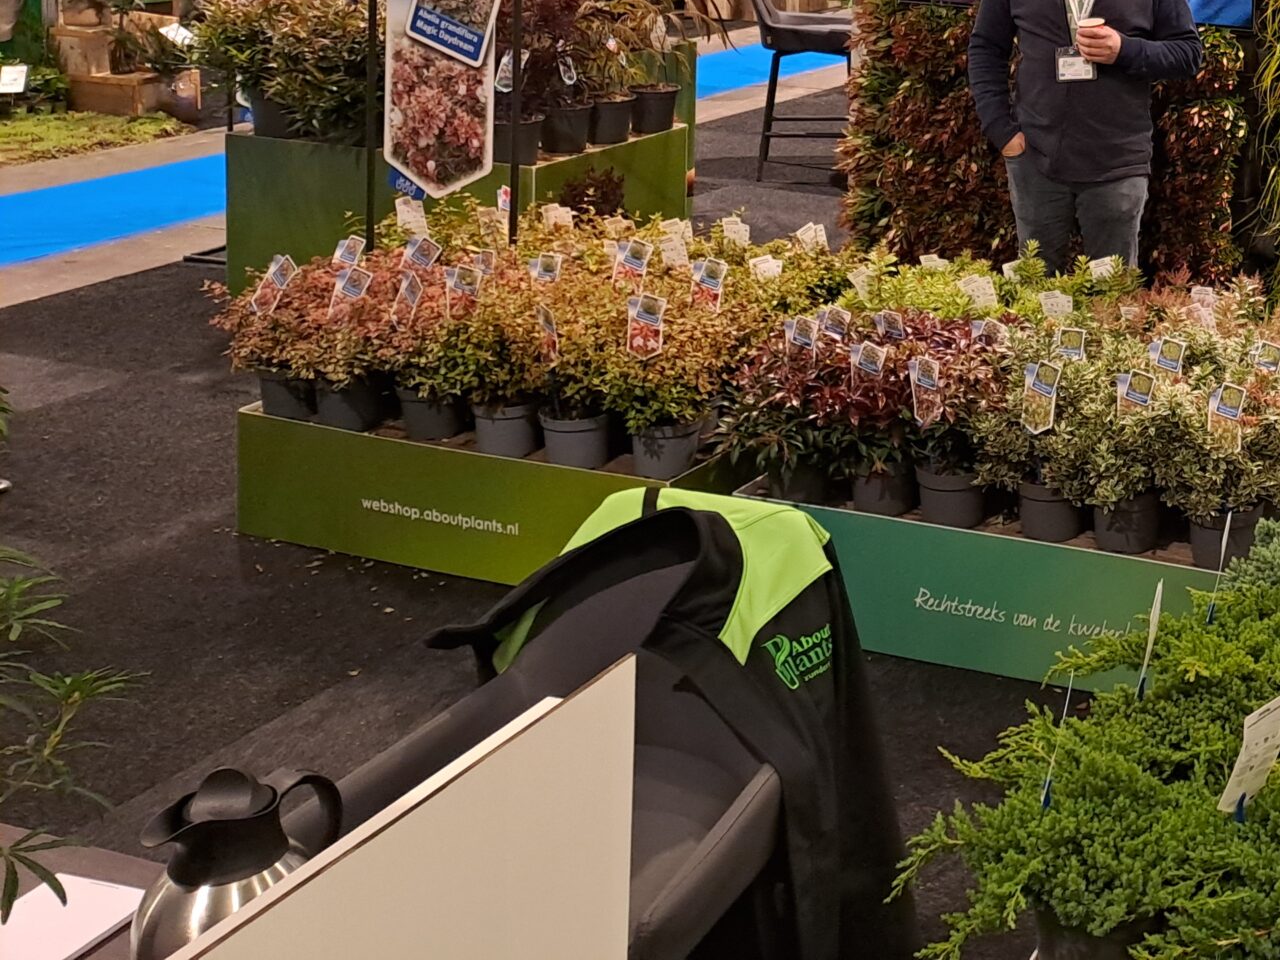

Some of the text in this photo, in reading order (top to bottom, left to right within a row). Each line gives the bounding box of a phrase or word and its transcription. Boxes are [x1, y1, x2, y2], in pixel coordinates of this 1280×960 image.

[417, 8, 440, 25] Abelia
[415, 19, 475, 53] Magic Daydream
[361, 498, 519, 536] webshop.aboutplants.nl
[914, 587, 1005, 623] Rechtstreeks
[1012, 613, 1037, 628] van
[1042, 614, 1061, 632] de
